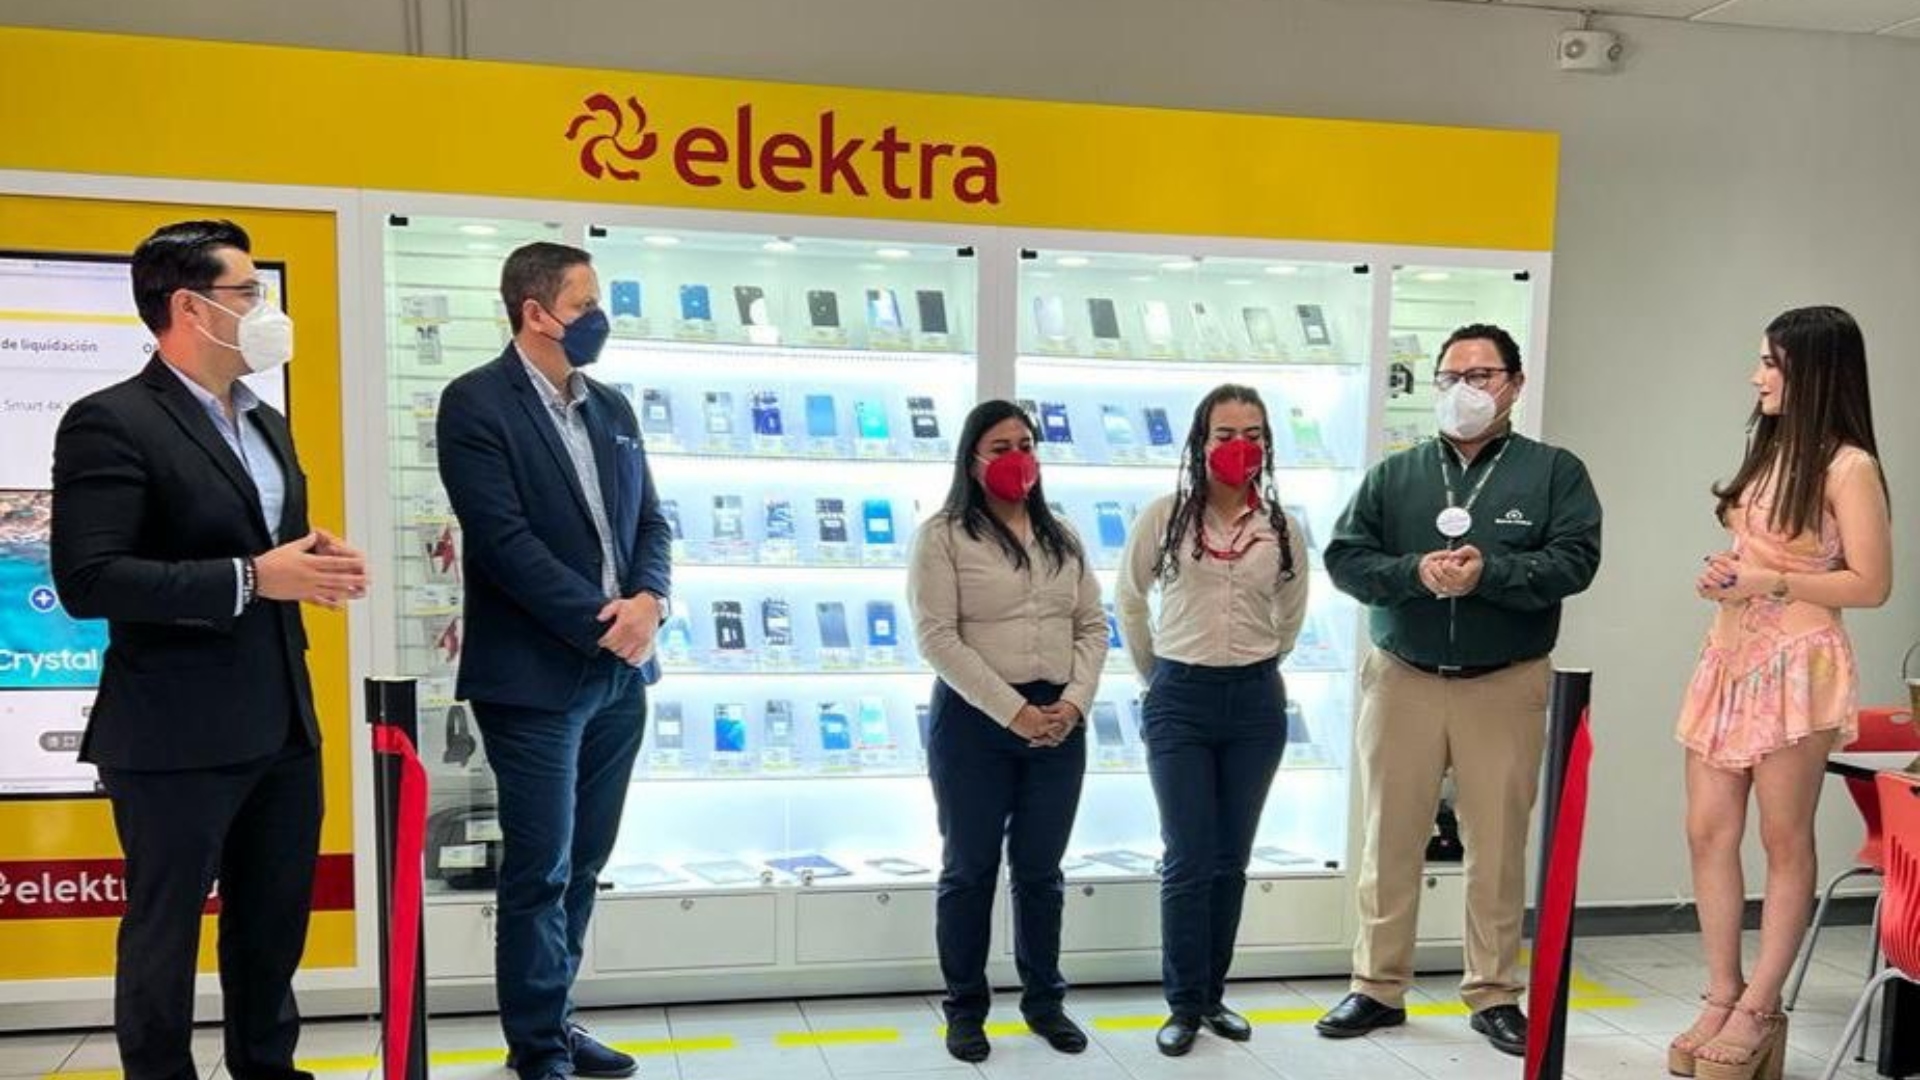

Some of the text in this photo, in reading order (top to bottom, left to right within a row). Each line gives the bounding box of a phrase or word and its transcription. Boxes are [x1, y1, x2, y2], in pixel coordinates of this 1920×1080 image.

[673, 103, 1001, 204] elektra
[2, 338, 98, 353] de liquidación
[0, 649, 98, 679] Crystal
